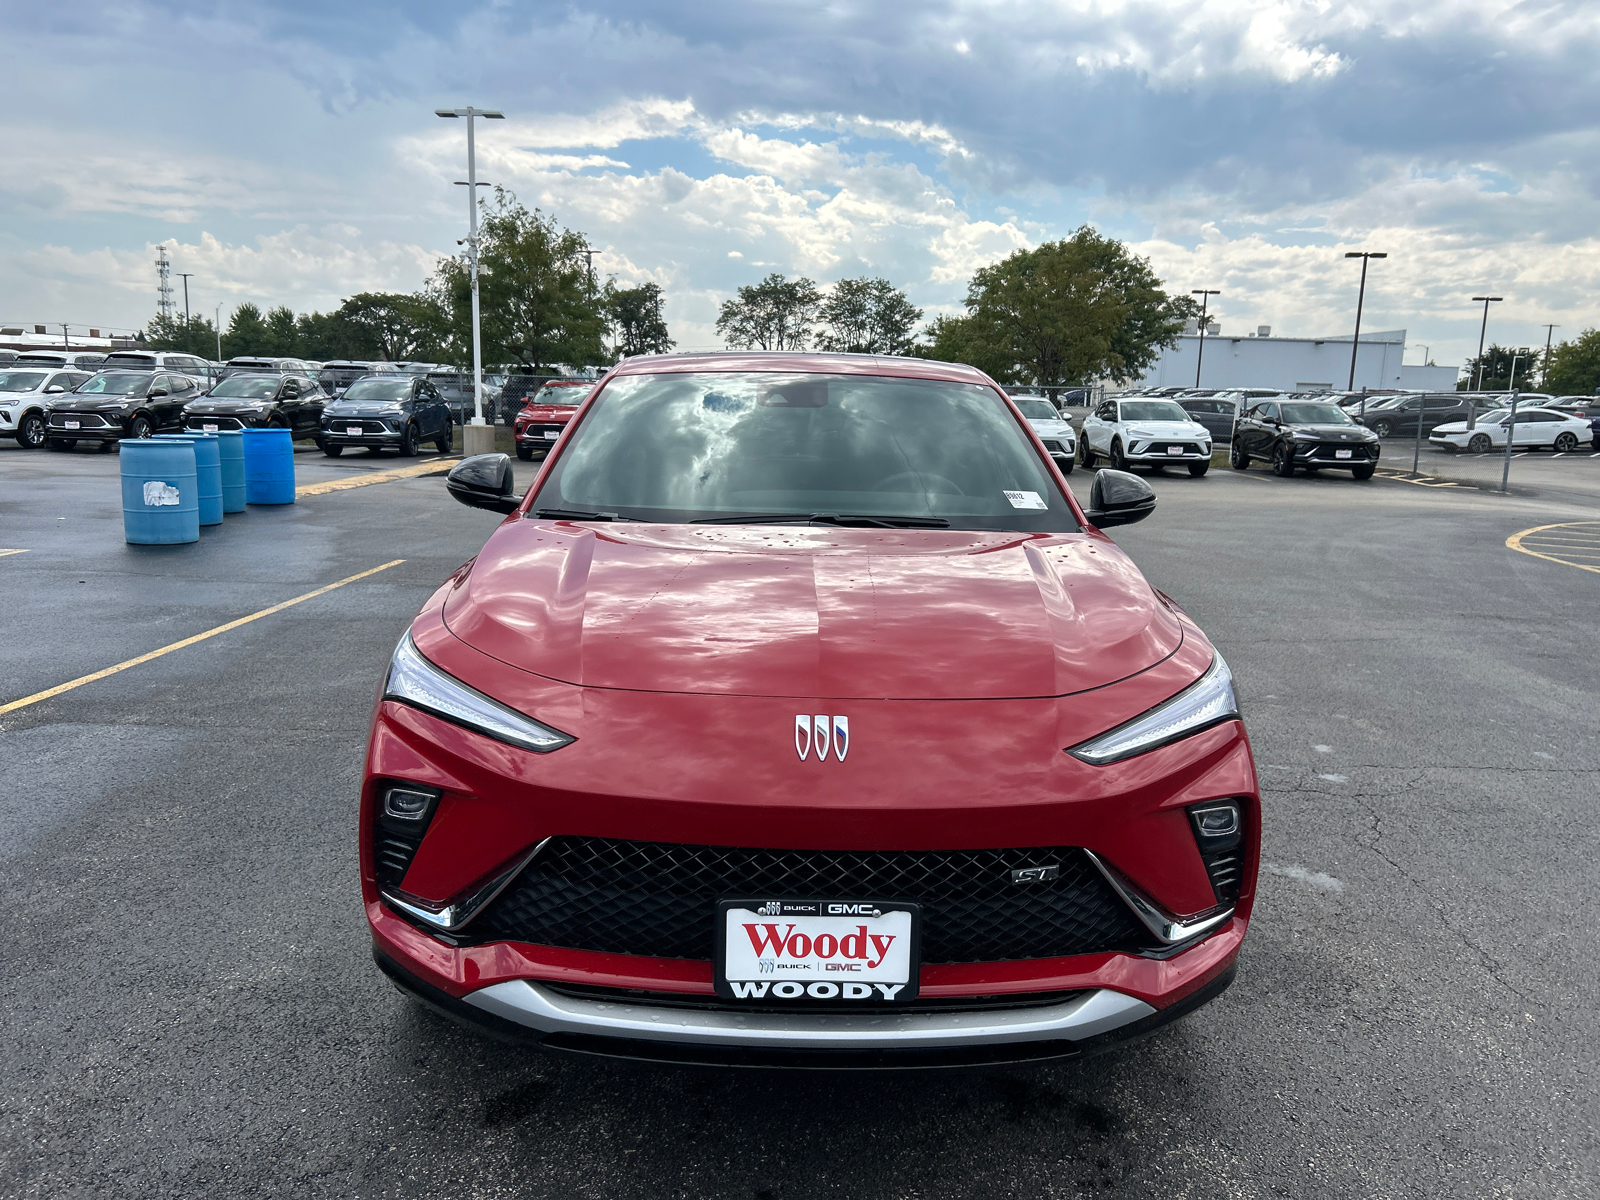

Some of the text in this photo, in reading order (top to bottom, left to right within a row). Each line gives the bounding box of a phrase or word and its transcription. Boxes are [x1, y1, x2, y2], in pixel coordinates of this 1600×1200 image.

[1014, 866, 1057, 883] ST
[828, 904, 873, 914] GMC
[742, 923, 896, 968] Woody
[825, 963, 861, 972] GMC
[729, 981, 905, 1000] WOODY
